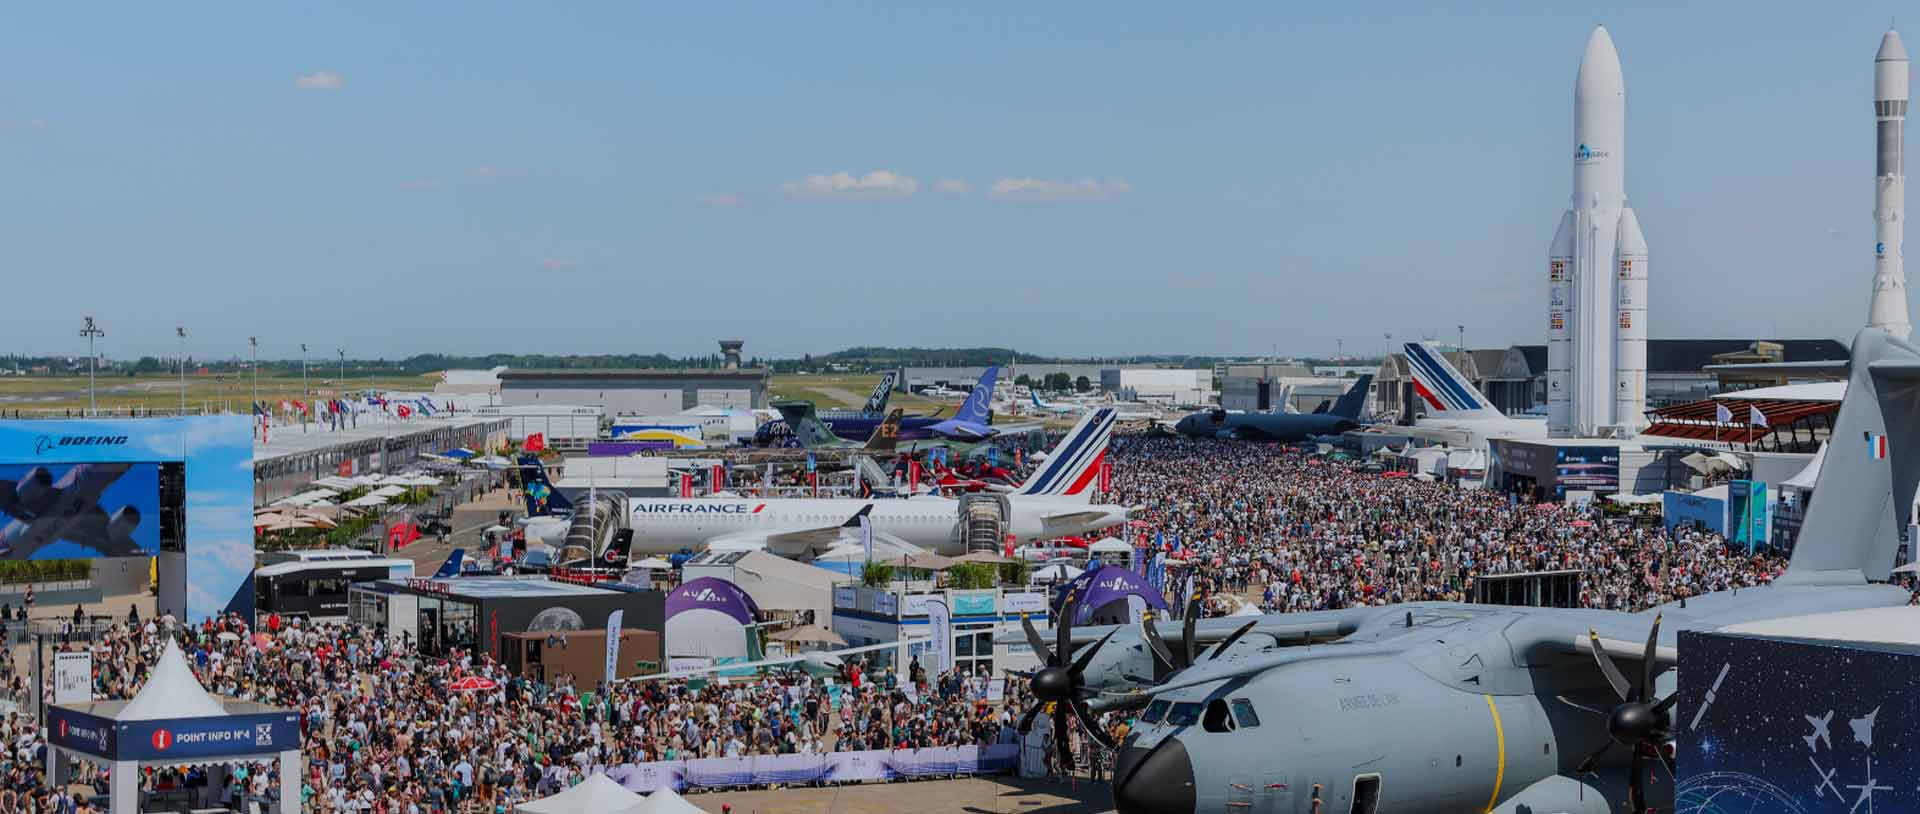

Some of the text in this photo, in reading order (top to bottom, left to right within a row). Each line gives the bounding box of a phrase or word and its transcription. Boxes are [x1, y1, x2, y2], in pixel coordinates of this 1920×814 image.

[881, 423, 898, 438] E2
[59, 435, 129, 446] BOEING
[633, 503, 747, 514] AIRFRANCE
[176, 732, 206, 744] POINT
[208, 730, 231, 741] INFO
